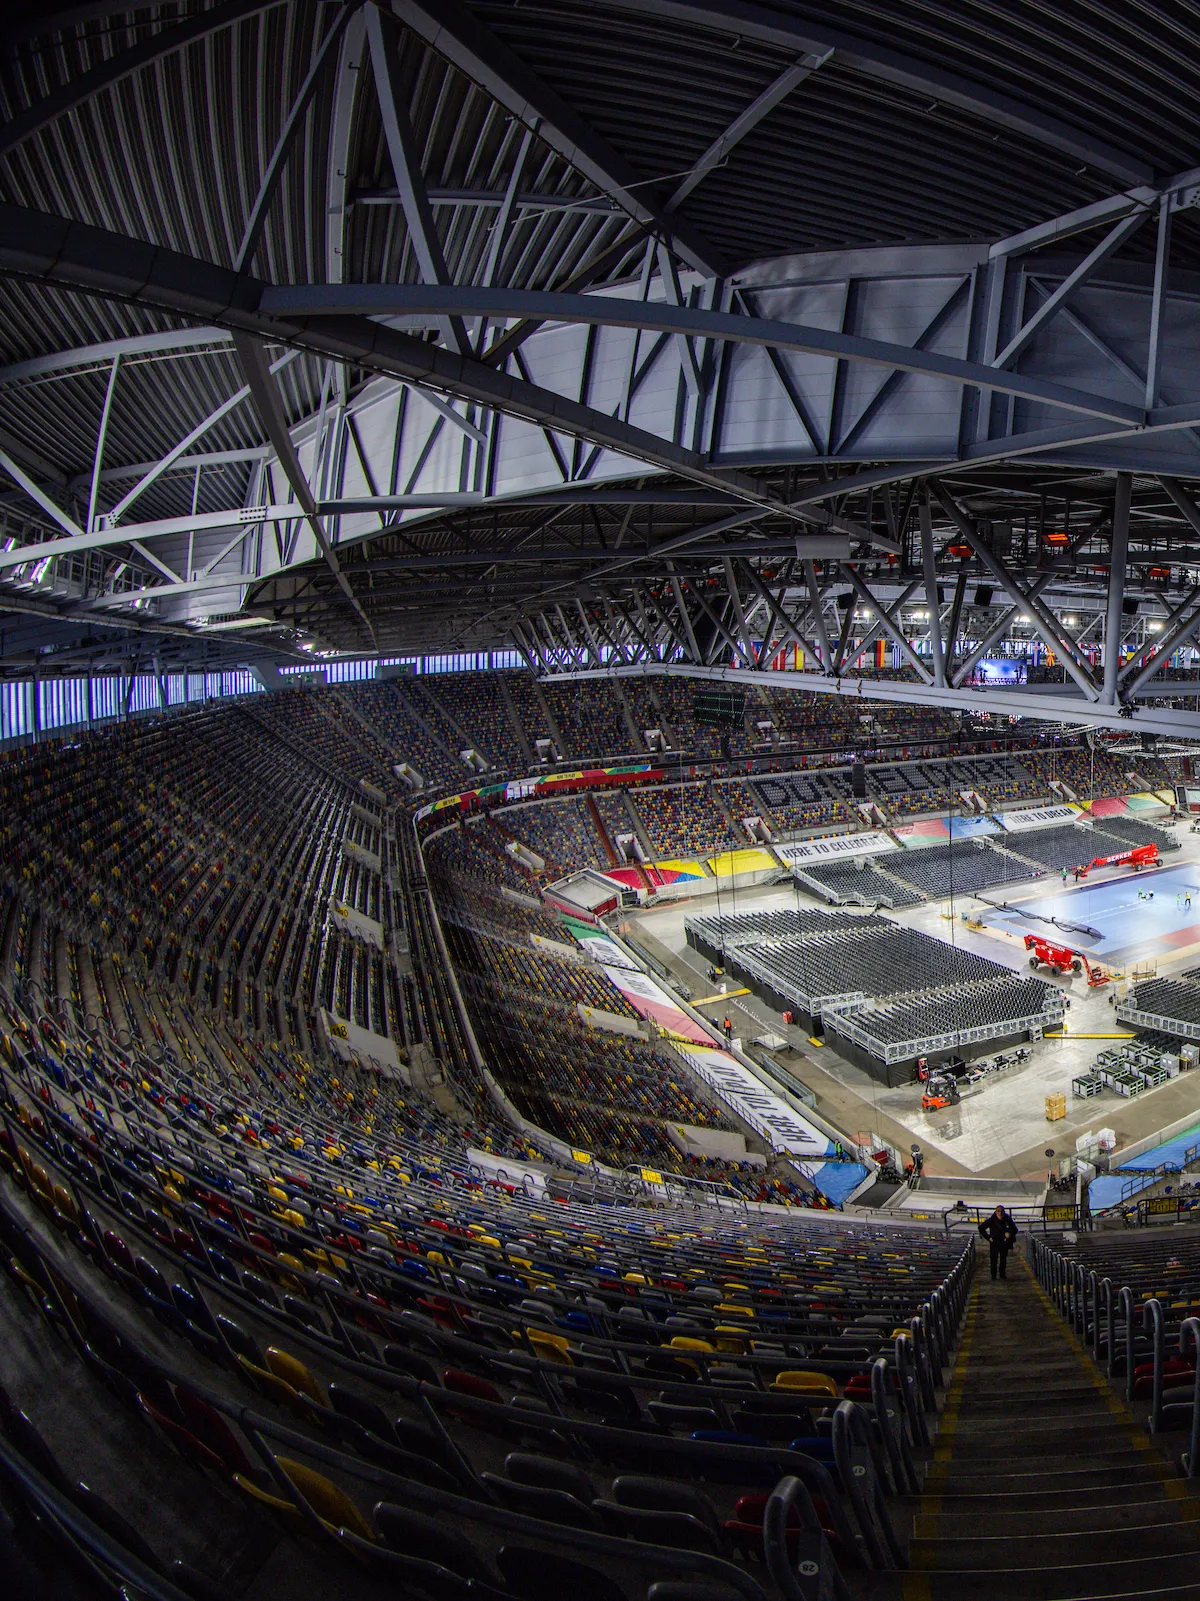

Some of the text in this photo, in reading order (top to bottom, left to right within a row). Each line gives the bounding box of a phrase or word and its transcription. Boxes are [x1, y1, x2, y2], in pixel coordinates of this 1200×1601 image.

[1008, 807, 1077, 825] HERE TO DREAM
[781, 845, 814, 859] HERE
[811, 843, 831, 855] TO
[705, 1062, 818, 1144] HERE TO PLAY
